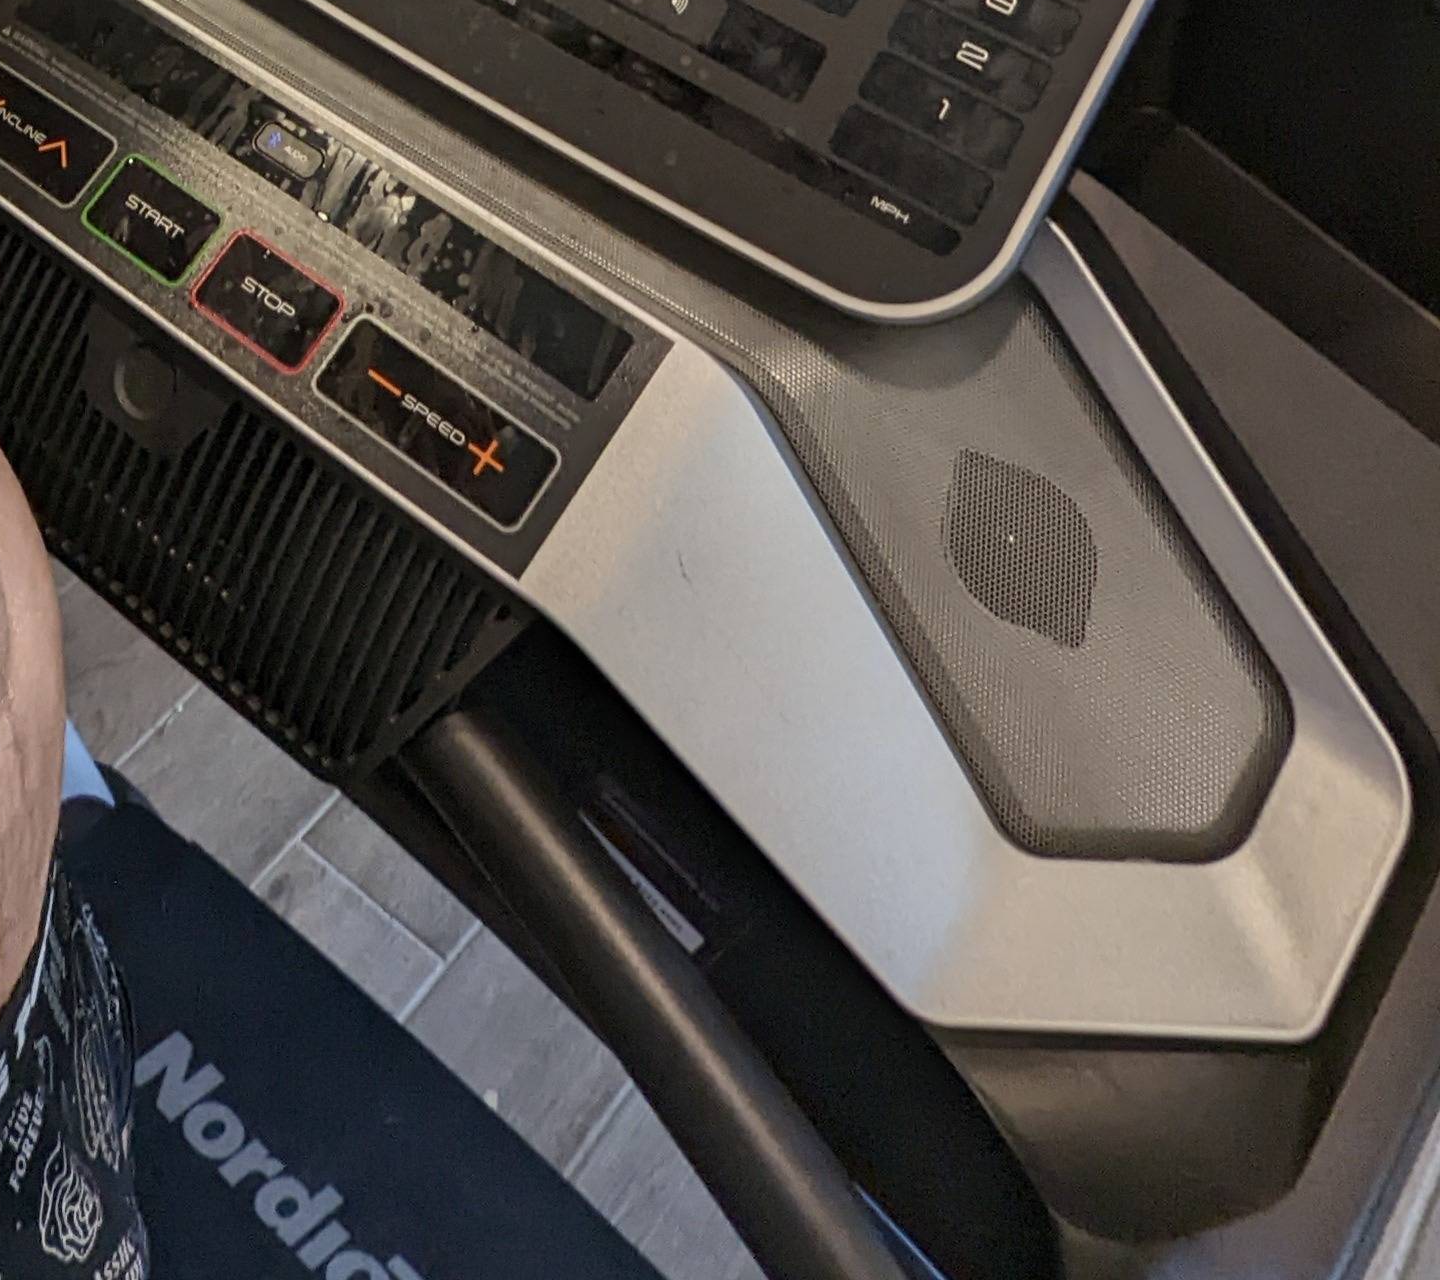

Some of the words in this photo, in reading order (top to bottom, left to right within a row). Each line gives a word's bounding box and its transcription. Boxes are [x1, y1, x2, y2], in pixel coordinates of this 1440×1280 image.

[956, 41, 989, 71] 2
[939, 97, 951, 120] 1
[124, 193, 186, 240] START
[871, 195, 910, 224] MPH
[241, 276, 296, 318] STOP
[401, 394, 466, 446] SPEED
[134, 1030, 427, 1280] Nordic
